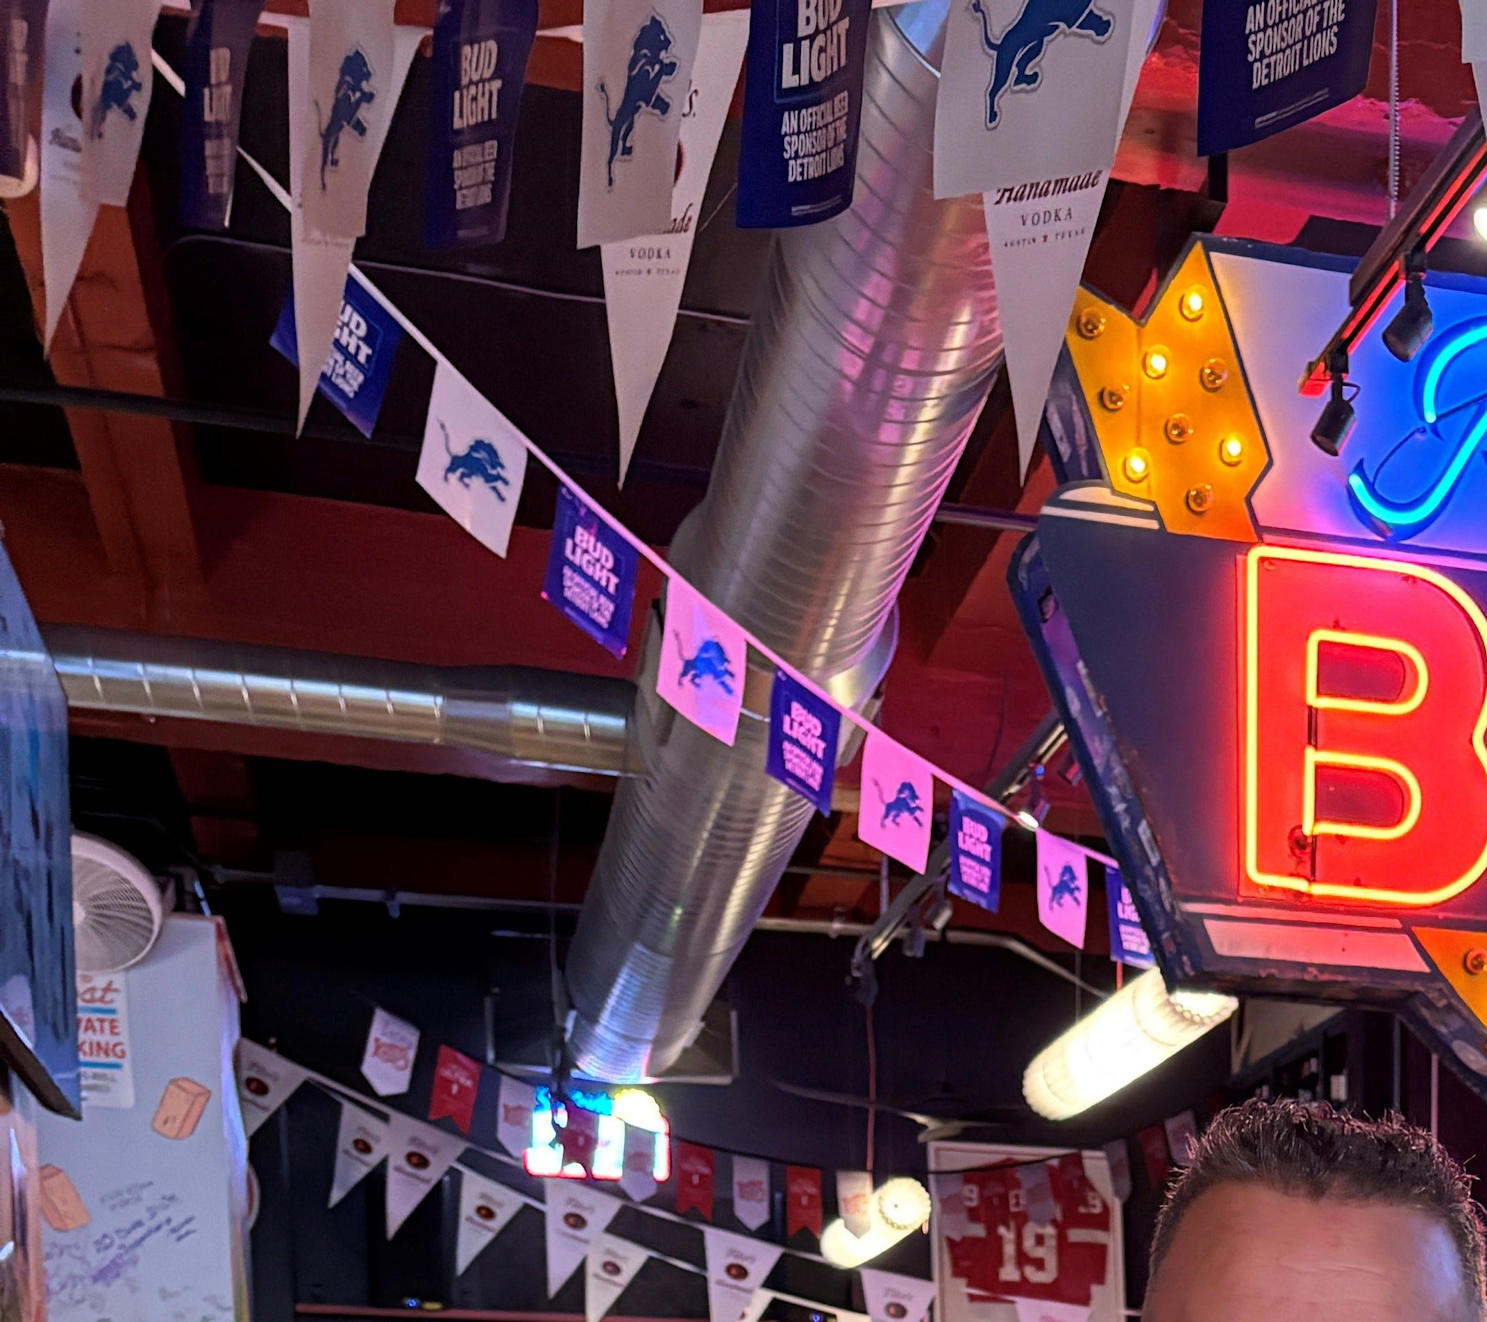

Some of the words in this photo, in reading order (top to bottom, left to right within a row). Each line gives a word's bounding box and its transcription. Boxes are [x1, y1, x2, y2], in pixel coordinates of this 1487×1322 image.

[1246, 2, 1265, 34] AN
[1247, 16, 1304, 62] SPONSOR
[1304, 7, 1322, 35] OF
[1322, 0, 1346, 28] THE
[461, 40, 498, 86] BUD
[782, 16, 849, 89] LIGHT
[1252, 42, 1303, 90] DETROIT
[1302, 25, 1339, 67] LIONS
[453, 79, 502, 130] LIGHT
[781, 111, 798, 135] AN
[1021, 207, 1073, 227] VODKA
[564, 538, 620, 595] LIGHT
[574, 525, 614, 570] BUD
[998, 1221, 1059, 1284] 19
